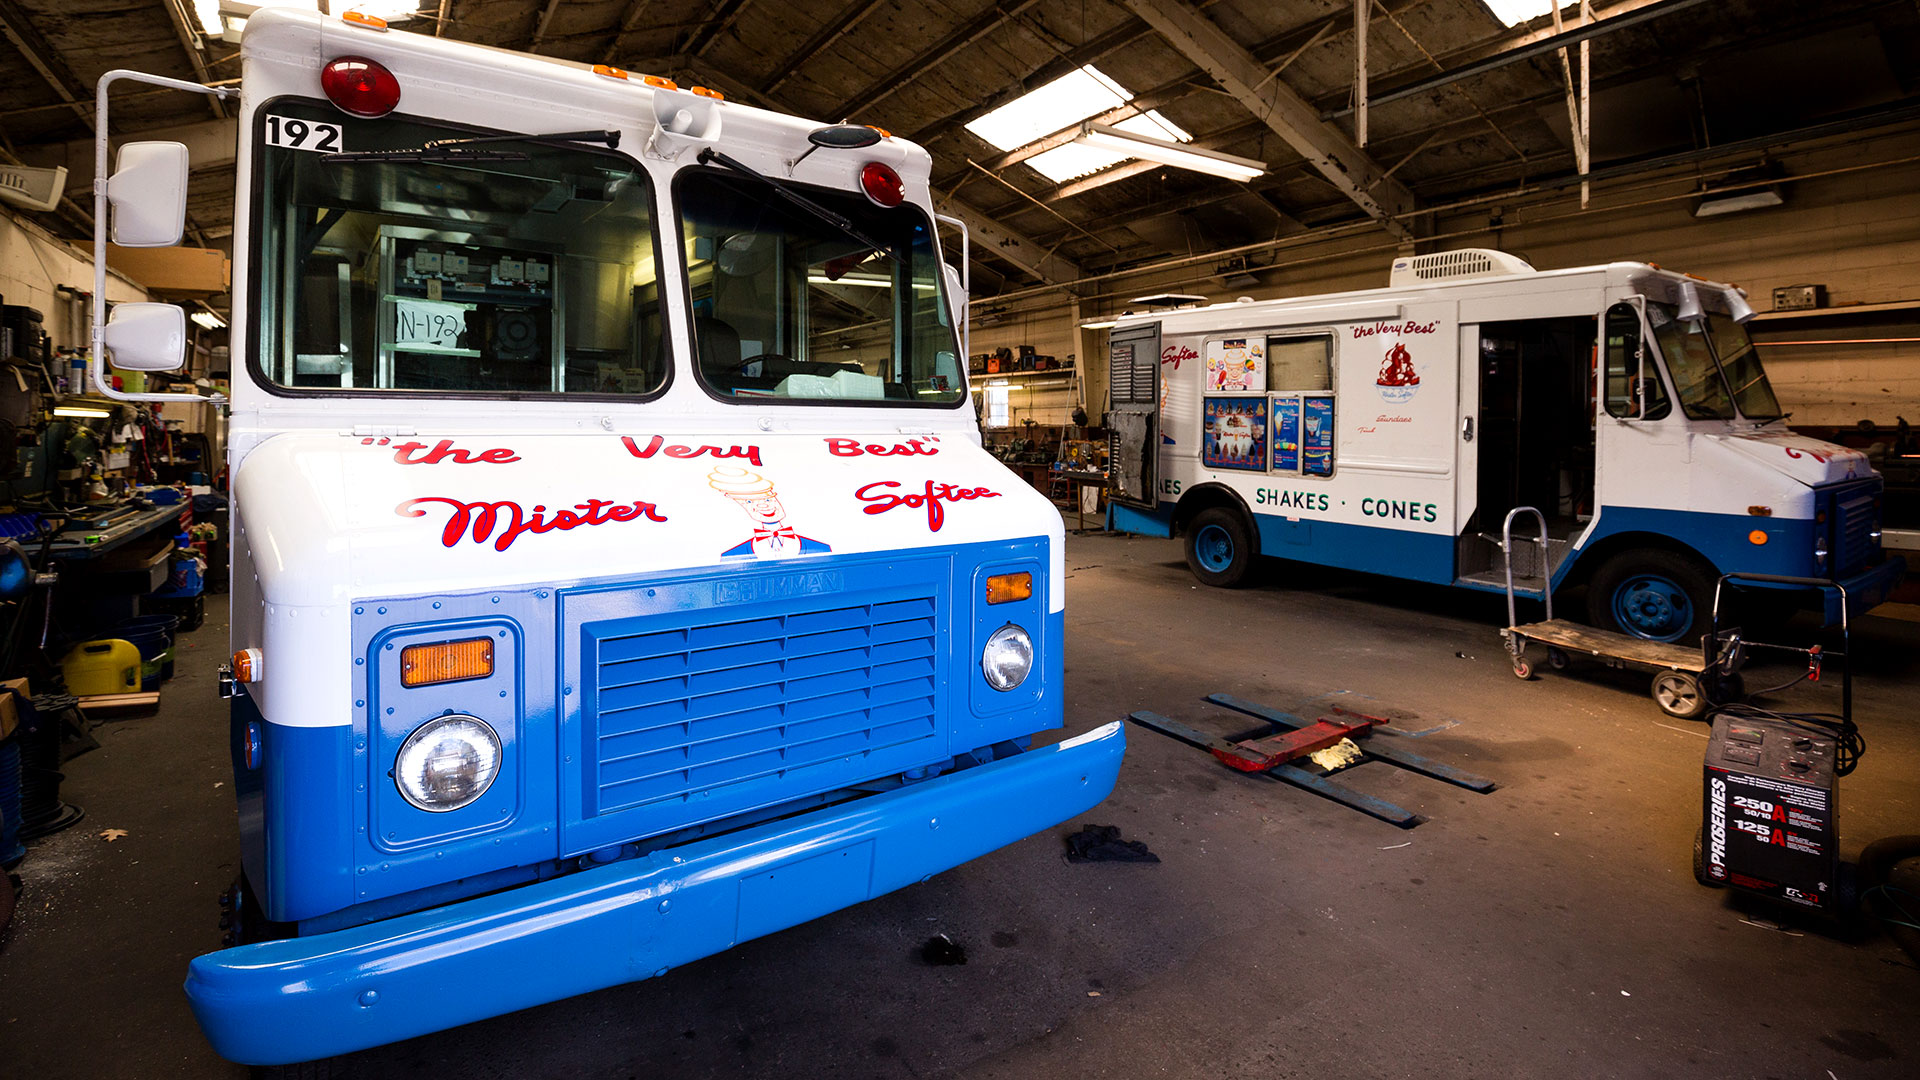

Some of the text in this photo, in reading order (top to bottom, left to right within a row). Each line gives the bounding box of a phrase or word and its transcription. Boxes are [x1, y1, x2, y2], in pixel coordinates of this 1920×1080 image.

[267, 116, 339, 153] 192
[401, 310, 459, 341] N-192
[1376, 320, 1402, 337] Very
[1161, 345, 1199, 371] Softee
[621, 435, 763, 467] Very
[394, 479, 1003, 552] Mister Softee
[1256, 487, 1329, 512] SHAKES
[1362, 497, 1437, 523] CONES
[1710, 777, 1727, 868] PROSERIES
[1744, 808, 1772, 820] 50/10
[1756, 834, 1770, 843] 50
